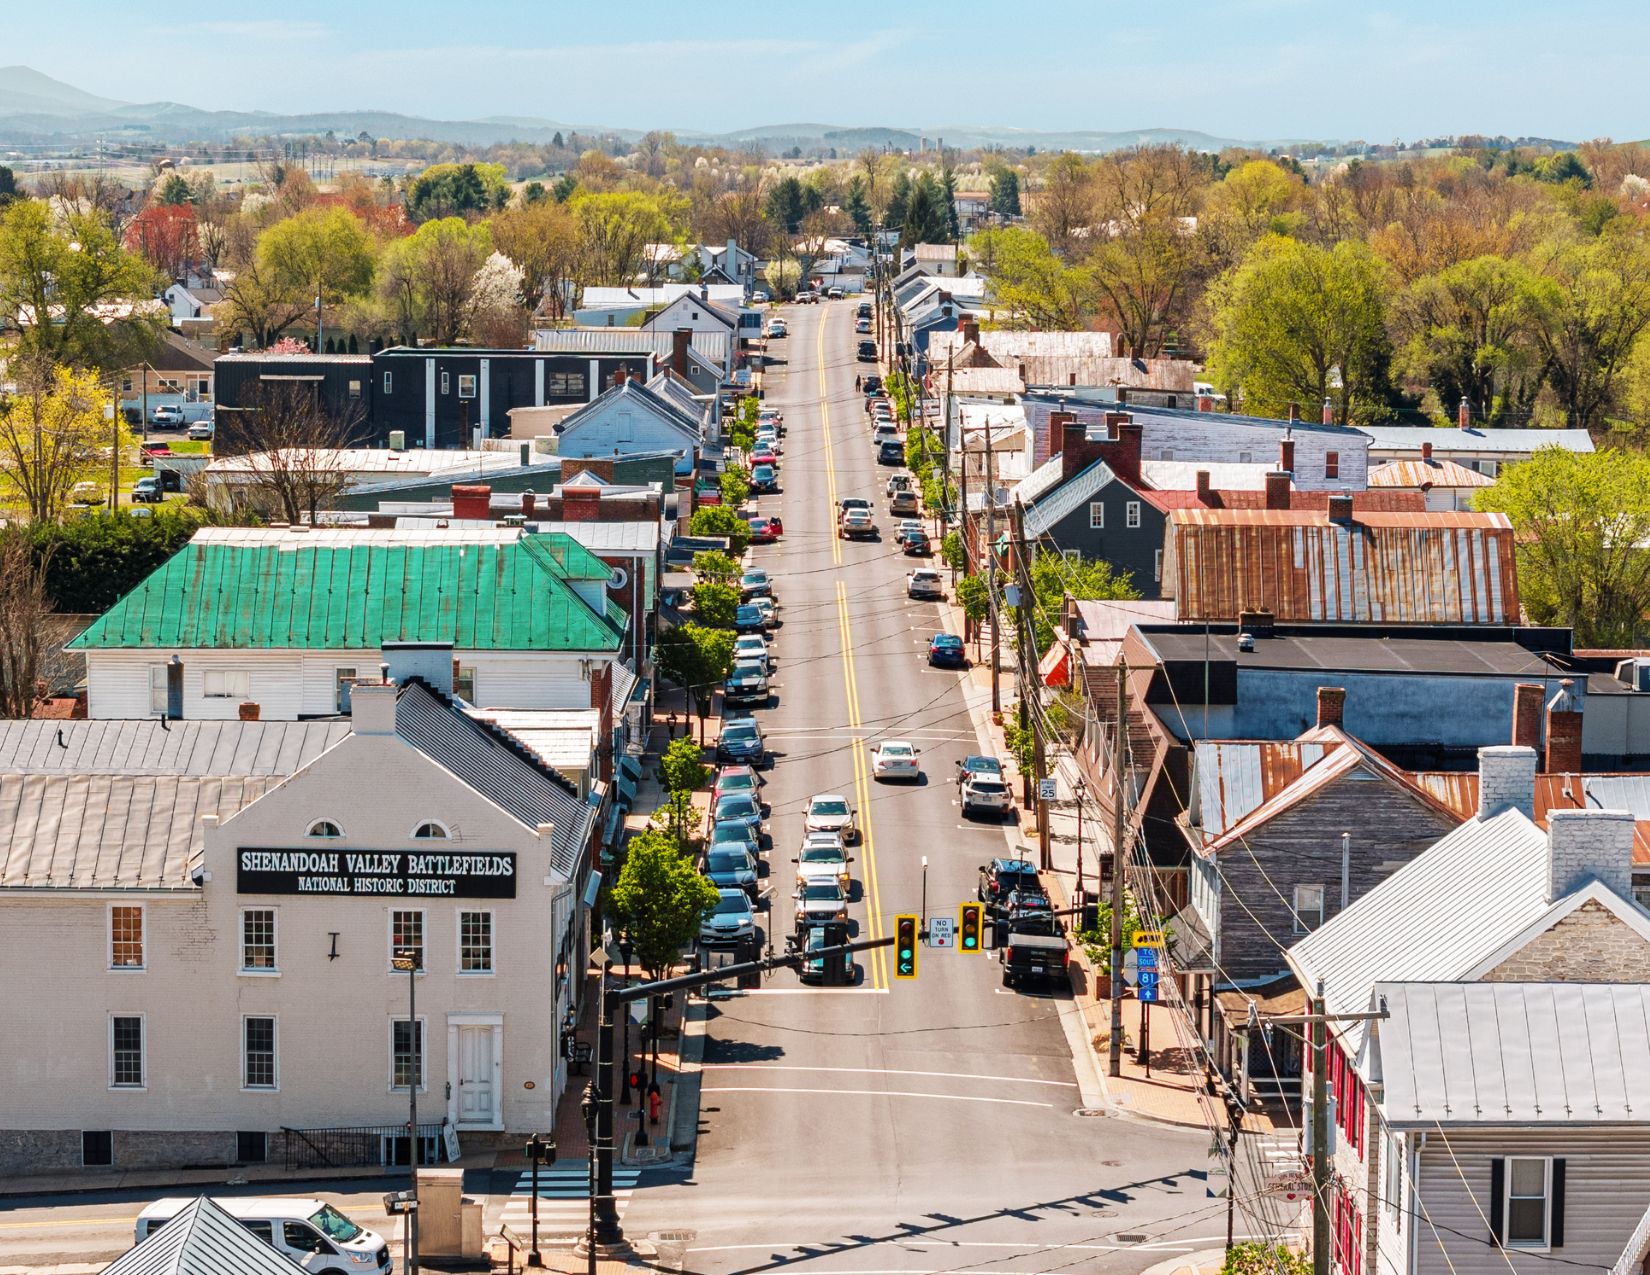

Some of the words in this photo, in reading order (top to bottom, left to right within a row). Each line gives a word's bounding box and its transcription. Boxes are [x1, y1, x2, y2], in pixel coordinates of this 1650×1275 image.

[1041, 789, 1055, 797] 25
[241, 851, 339, 873] SHENANDOAH
[345, 853, 401, 874] VALLEY
[407, 854, 514, 876] BATTLEFIELDS
[298, 876, 351, 892] NATIONAL
[353, 877, 404, 893] HISTORIC
[407, 878, 456, 894] DISTRICT
[1142, 973, 1154, 983] 81
